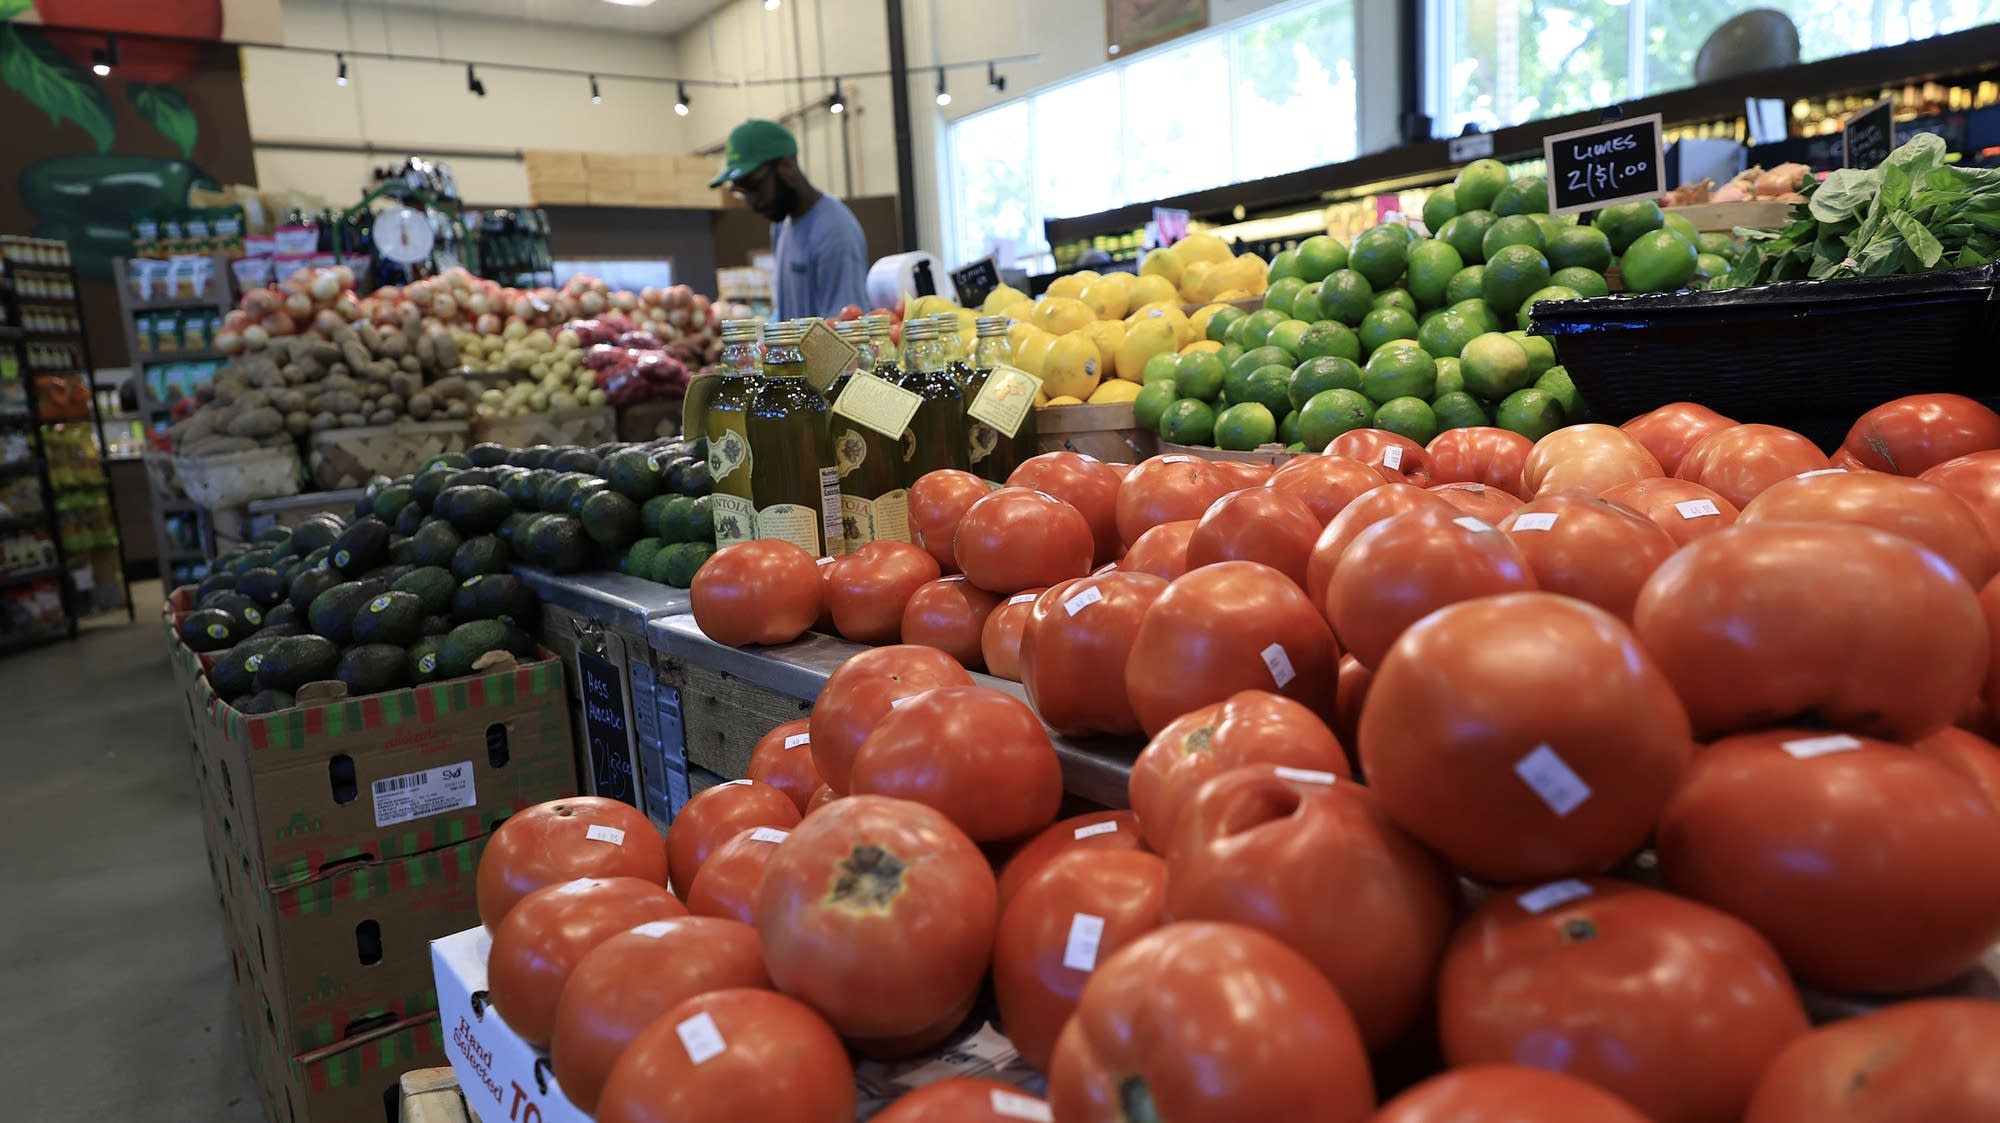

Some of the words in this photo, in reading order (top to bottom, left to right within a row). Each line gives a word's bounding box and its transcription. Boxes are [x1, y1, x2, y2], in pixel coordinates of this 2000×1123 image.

[453, 1026, 504, 1105] Selected
[459, 1015, 493, 1070] Hand
[510, 1079, 543, 1123] TO
